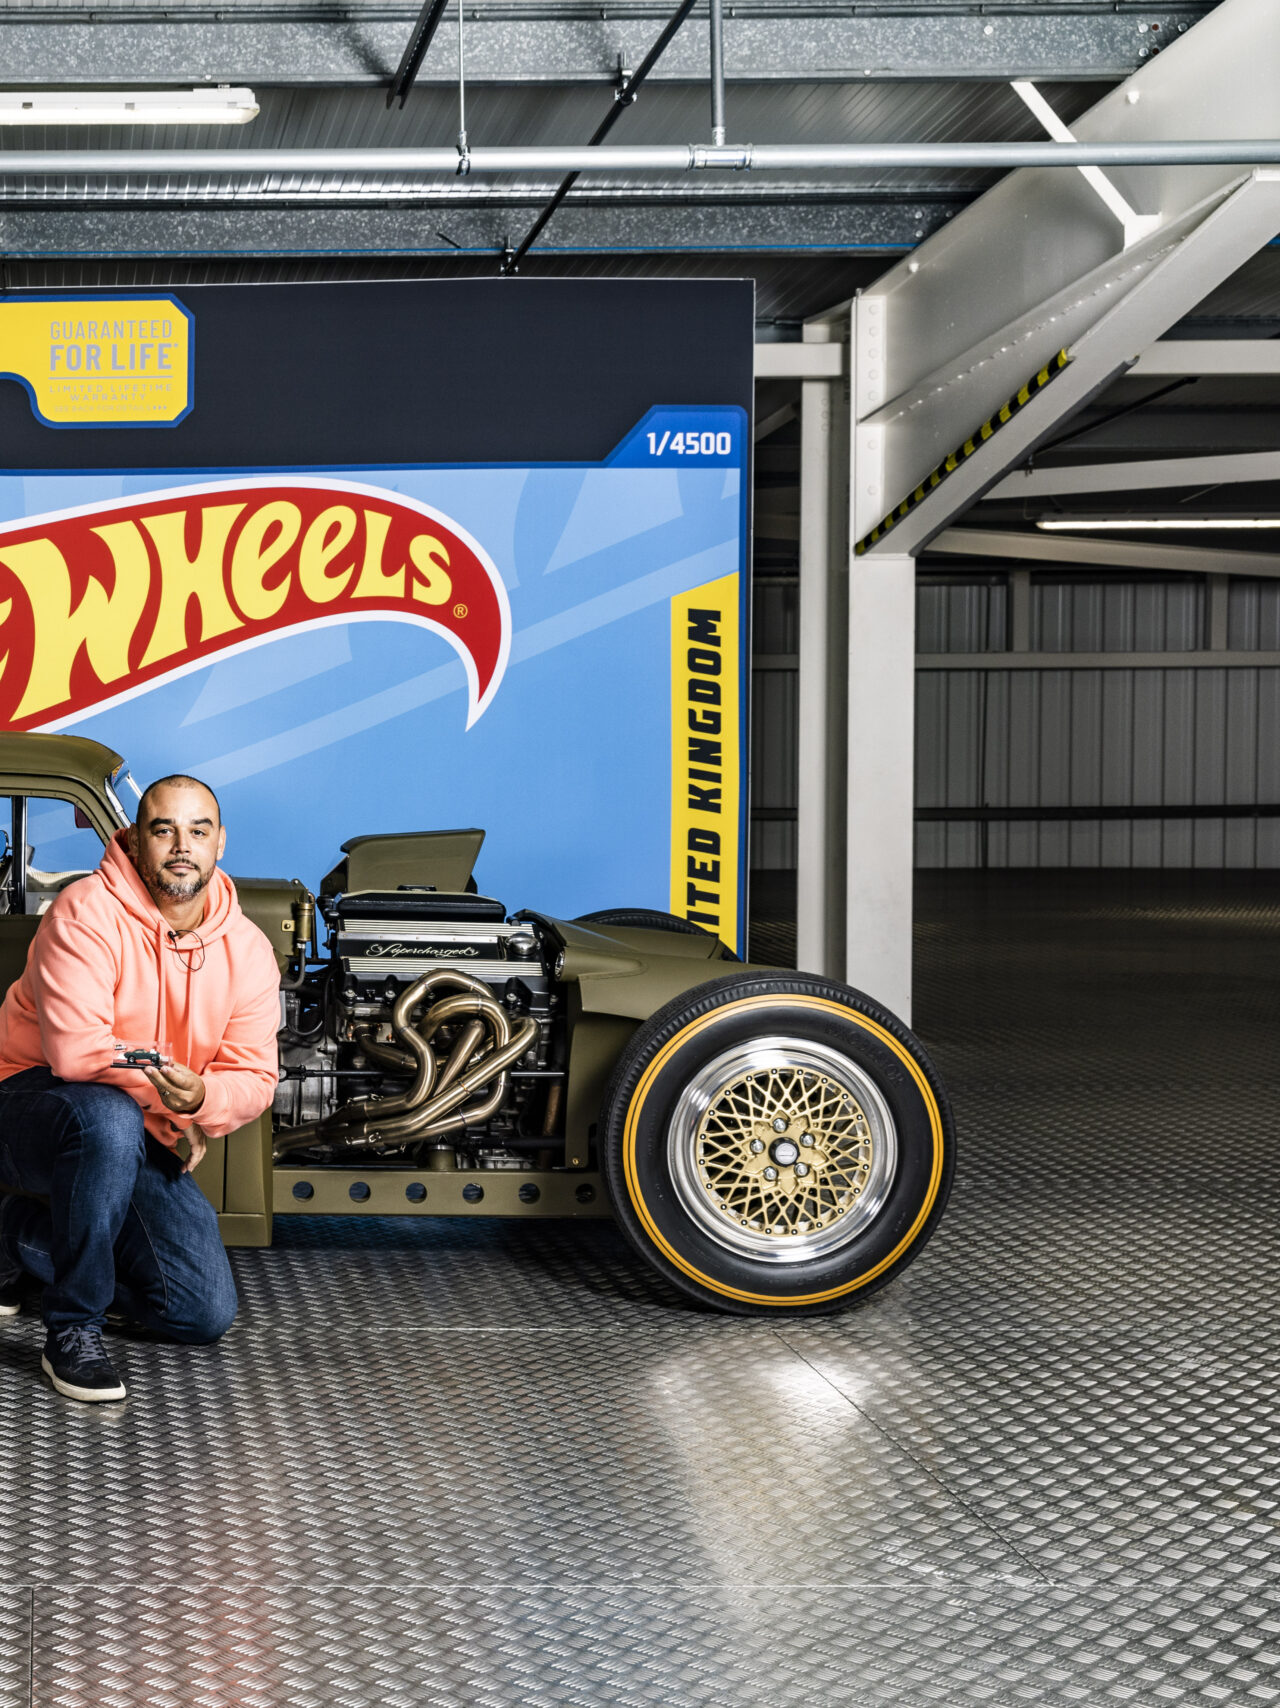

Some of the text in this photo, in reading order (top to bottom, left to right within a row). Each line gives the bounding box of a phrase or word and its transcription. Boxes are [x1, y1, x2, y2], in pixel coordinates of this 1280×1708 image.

[50, 320, 172, 340] GUARANTEED
[50, 344, 101, 371] FOR
[49, 383, 173, 393] LIMITED LIFETIME
[70, 393, 147, 401] WARRANTY
[646, 432, 732, 456] 1/4500
[687, 608, 722, 814] KINGDOM
